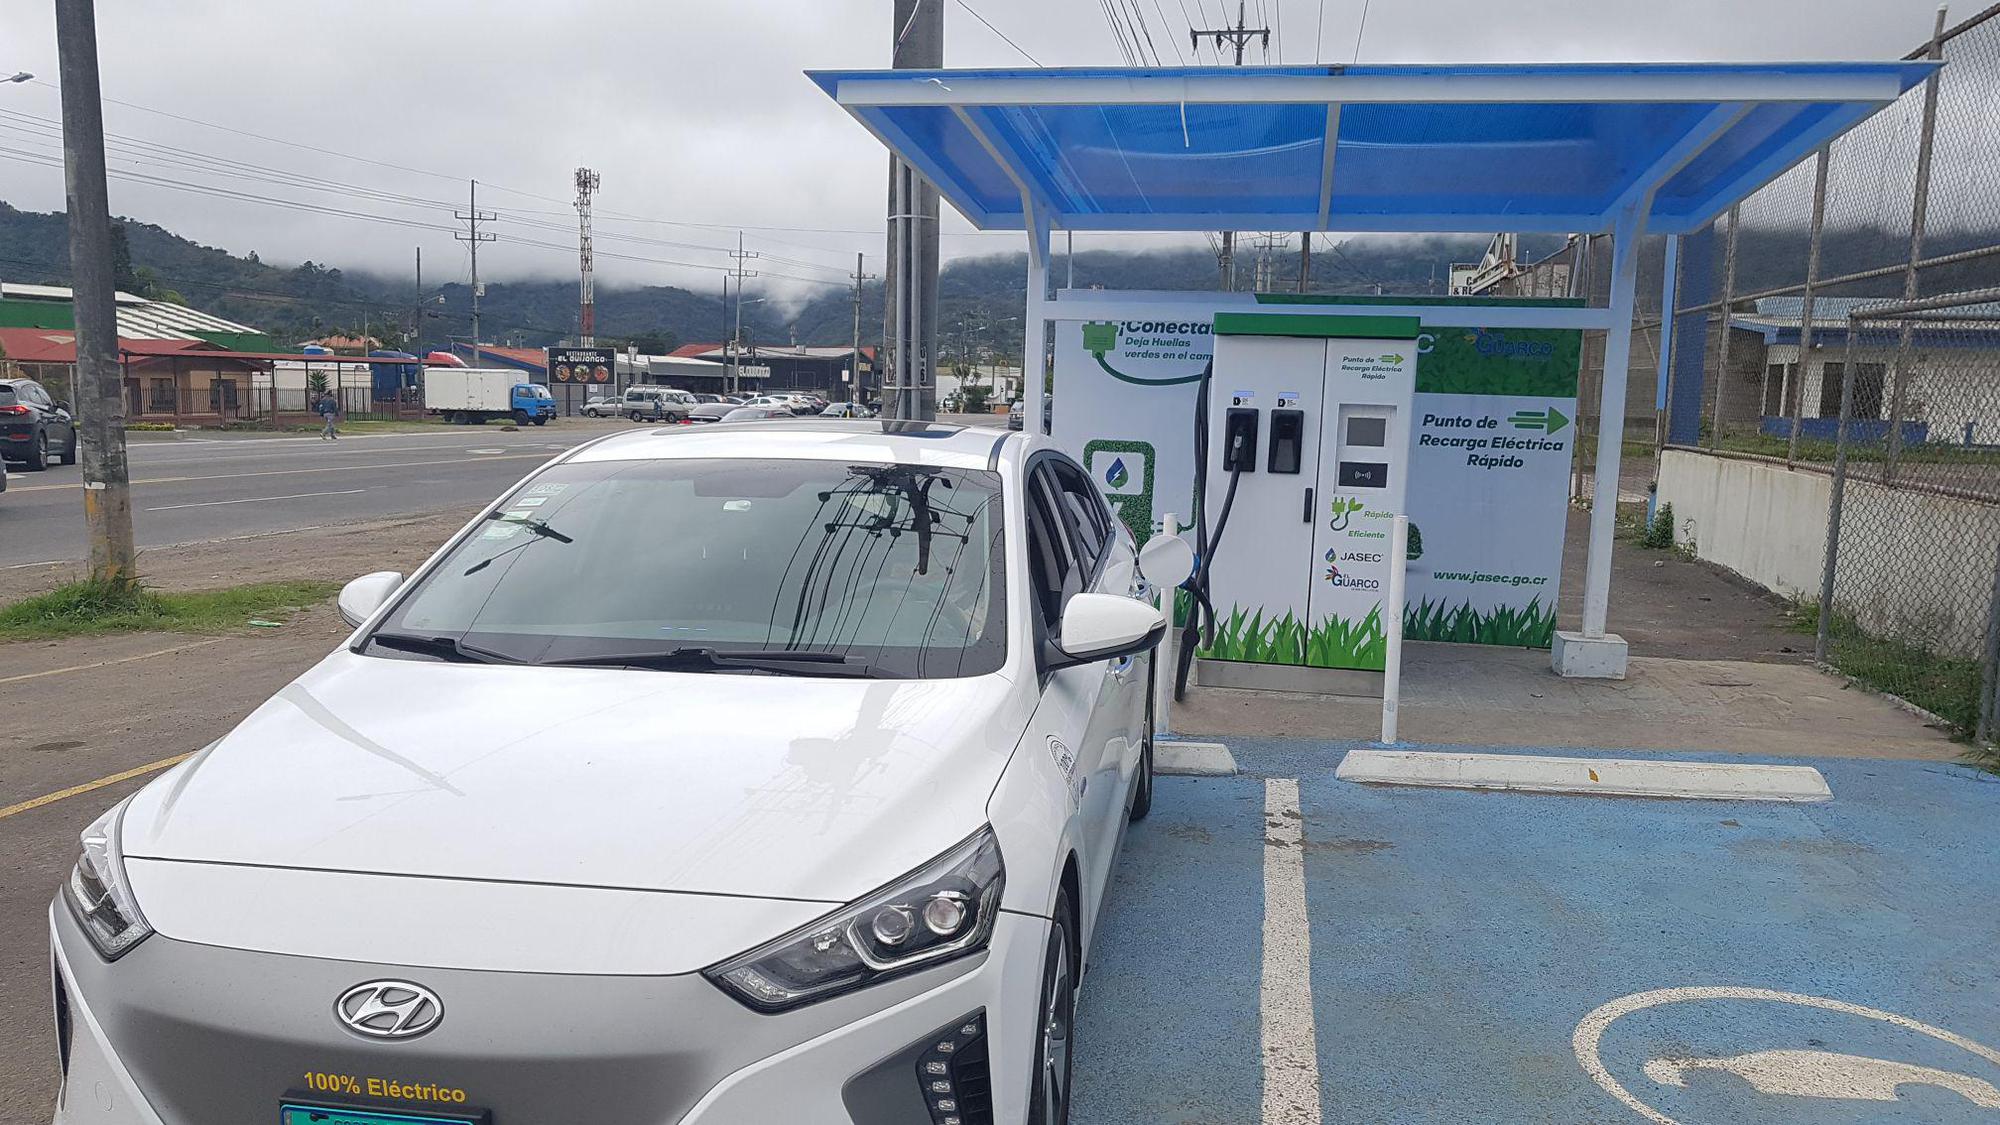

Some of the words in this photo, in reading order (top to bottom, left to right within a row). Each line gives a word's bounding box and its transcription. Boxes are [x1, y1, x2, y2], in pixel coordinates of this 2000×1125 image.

[1125, 337, 1149, 348] Deja
[1151, 338, 1191, 347] Huellas
[1125, 351, 1160, 359] verdes
[1178, 351, 1188, 359] el
[1422, 414, 1472, 428] Punto
[1476, 416, 1498, 429] de
[1419, 434, 1487, 450] Recarga
[1491, 436, 1564, 451] Eléctrica
[1466, 454, 1524, 470] Rápido
[1348, 530, 1385, 539] Eficiente
[1340, 552, 1381, 563] JASEC
[1433, 571, 1547, 586] www.jasec.go.cr
[304, 1071, 360, 1094] 100%
[367, 1077, 466, 1103] Eléctrico
